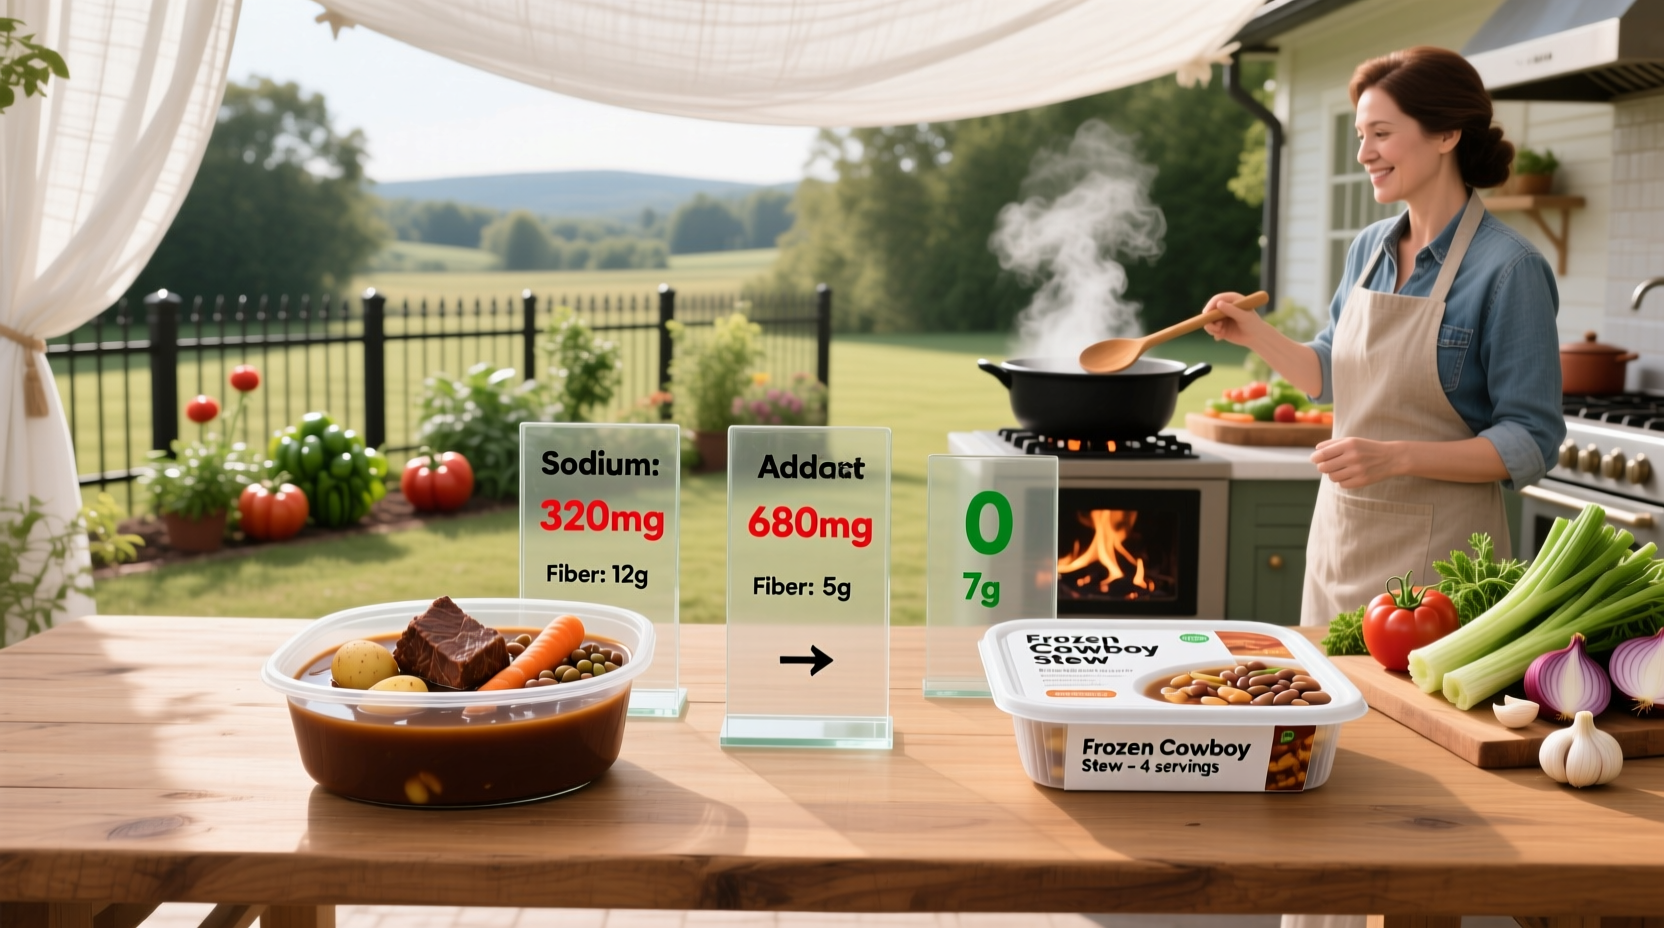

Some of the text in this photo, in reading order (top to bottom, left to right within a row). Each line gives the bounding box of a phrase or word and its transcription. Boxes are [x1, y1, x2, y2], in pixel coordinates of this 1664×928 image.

[542, 449, 660, 477] Sodium:
[539, 499, 665, 542] 320mg
[748, 505, 873, 548] 680mg
[965, 490, 1014, 556] 0
[547, 563, 648, 590] Fiber: 12g
[753, 575, 851, 602] Fiber: 5g
[962, 572, 1000, 608] 7g
[1026, 634, 1119, 645] Frozen
[1029, 643, 1159, 657] Cowboy
[1082, 737, 1252, 761] Frozen Cowboy
[1081, 758, 1124, 773] Stew
[1140, 759, 1151, 773] 4
[1154, 759, 1220, 777] servings
